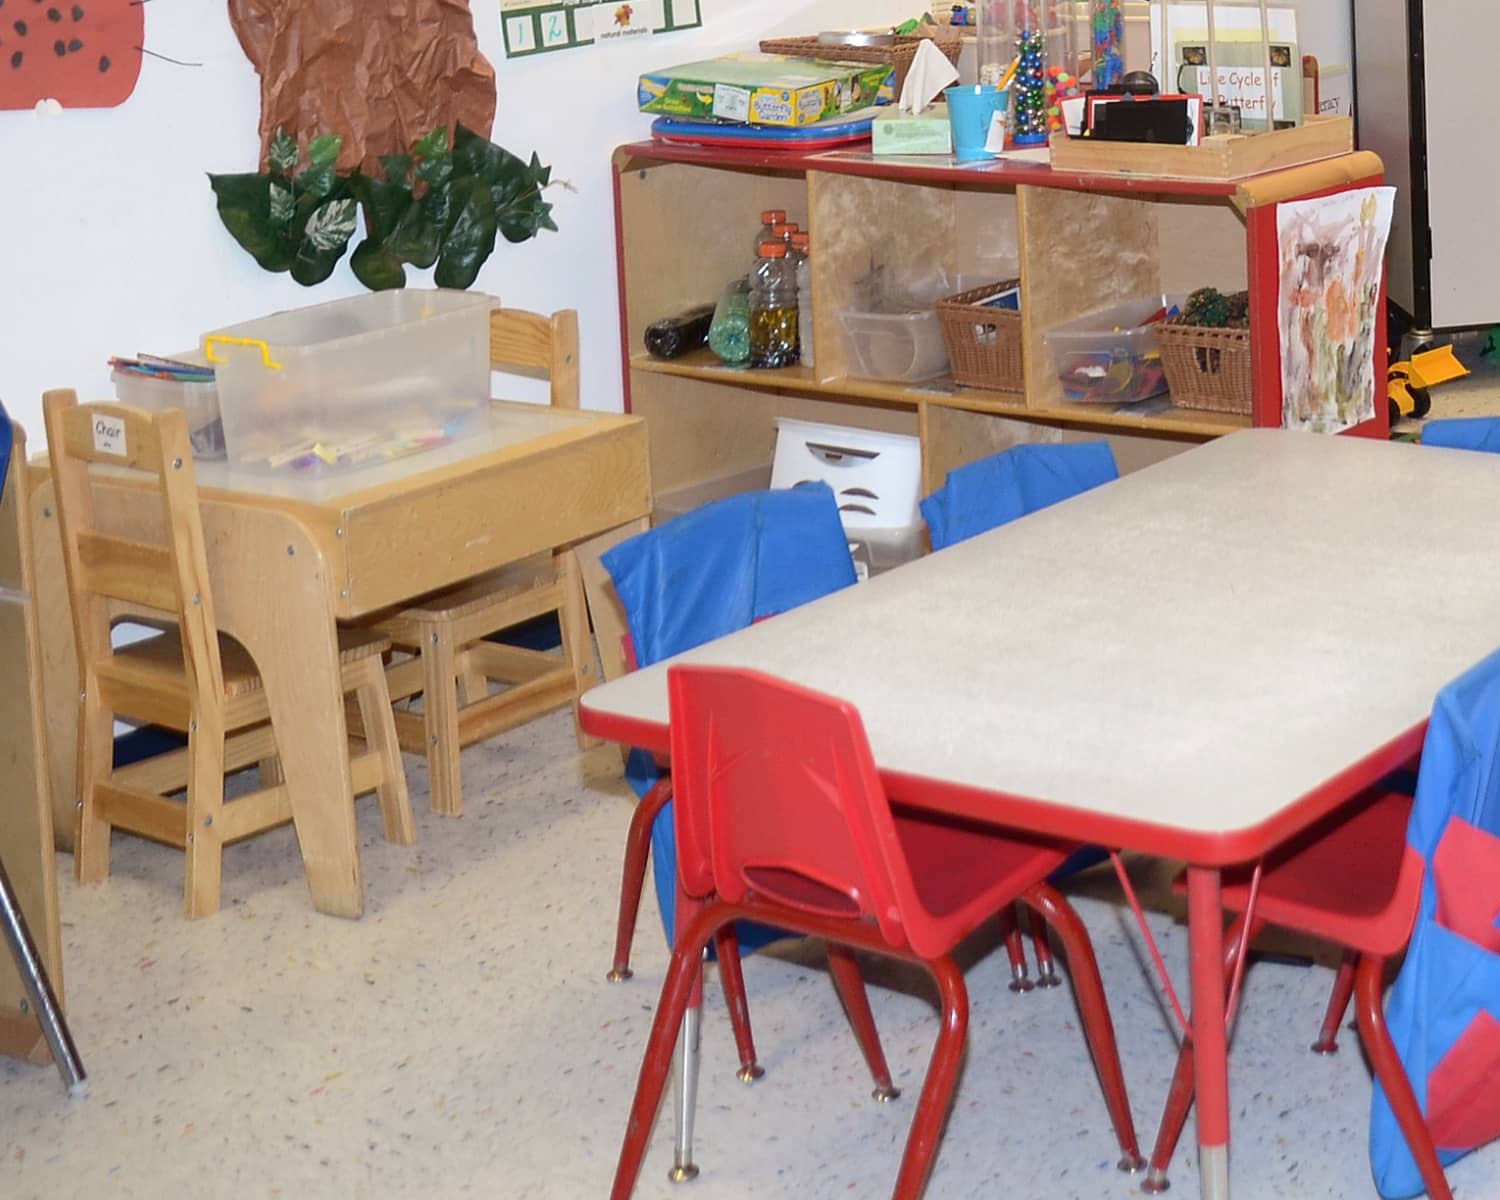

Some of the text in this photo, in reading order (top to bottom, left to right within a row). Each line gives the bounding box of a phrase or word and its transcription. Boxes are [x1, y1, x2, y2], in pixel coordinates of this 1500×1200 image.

[548, 15, 562, 41] 2
[601, 30, 621, 39] natural
[1200, 72, 1226, 86] Lie
[1229, 71, 1263, 89] Cycle
[1217, 94, 1277, 113] Butterfy
